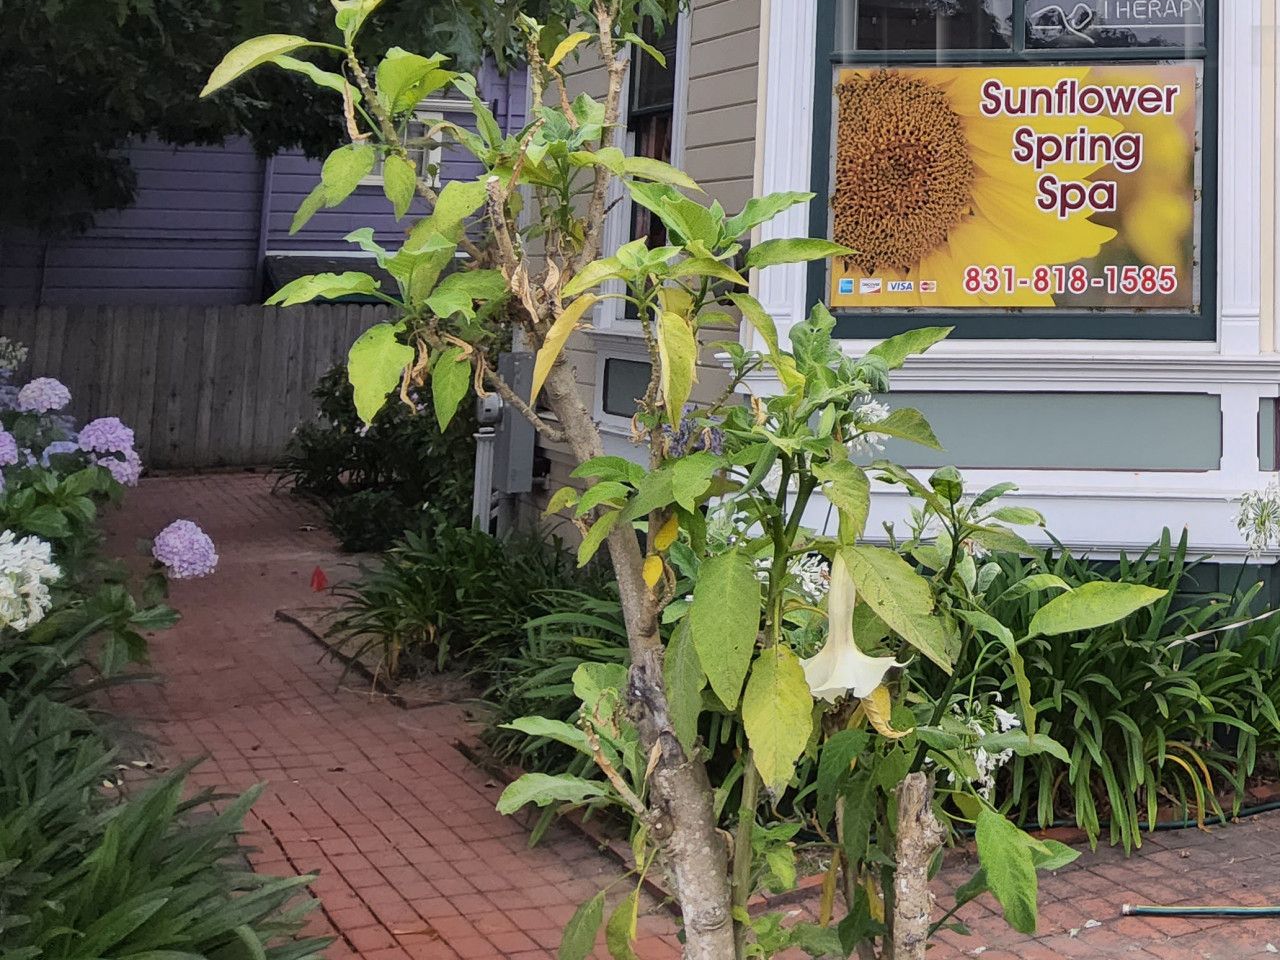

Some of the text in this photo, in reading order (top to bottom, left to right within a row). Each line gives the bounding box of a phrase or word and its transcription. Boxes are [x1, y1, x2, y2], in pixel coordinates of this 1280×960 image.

[981, 79, 1179, 115] Sunflower
[1013, 127, 1142, 170] Spring
[1036, 175, 1116, 218] Spa
[890, 282, 913, 290] VISA
[963, 266, 1177, 293] 831-818-1585
